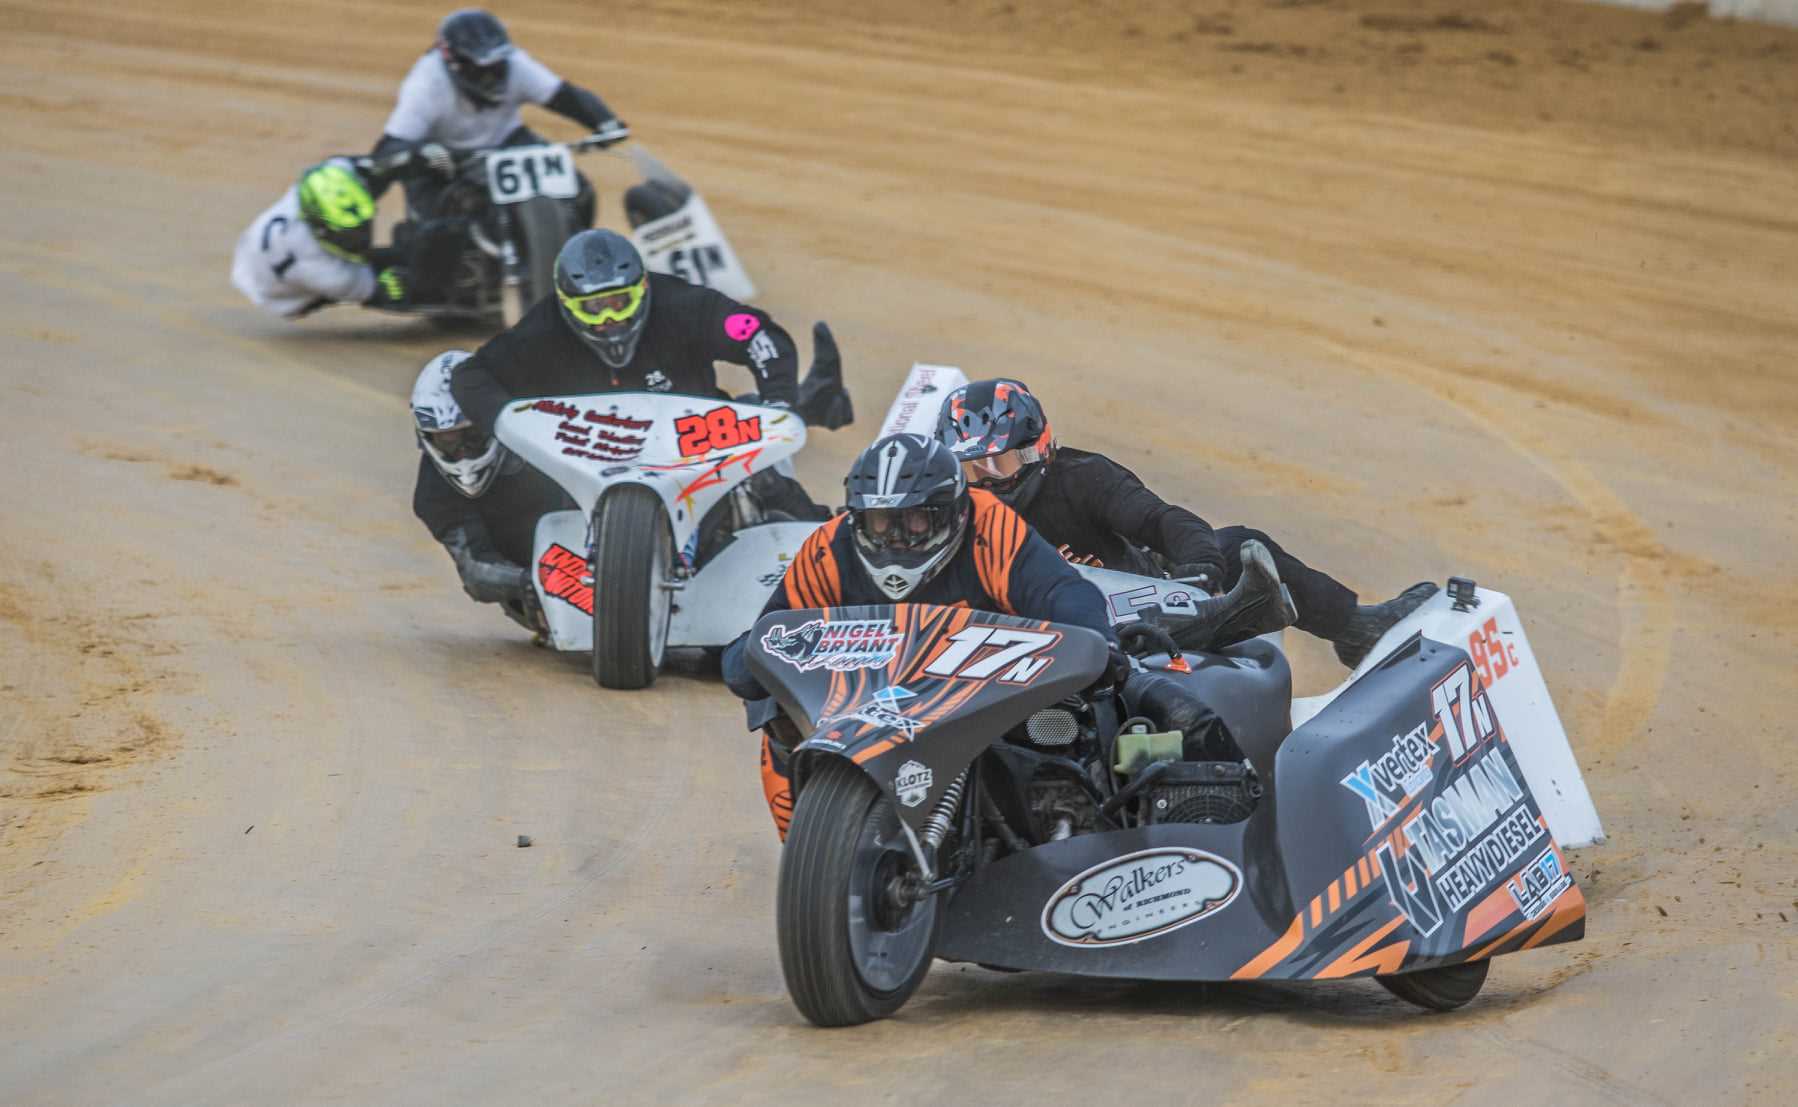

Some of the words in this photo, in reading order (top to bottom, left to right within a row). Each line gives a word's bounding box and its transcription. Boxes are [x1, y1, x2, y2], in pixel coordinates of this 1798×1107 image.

[815, 638, 899, 654] BRYANT
[824, 623, 887, 639] NIGEL
[1372, 722, 1439, 792] vertex
[1403, 747, 1524, 876] TASMAN
[1070, 859, 1185, 930] Walkers
